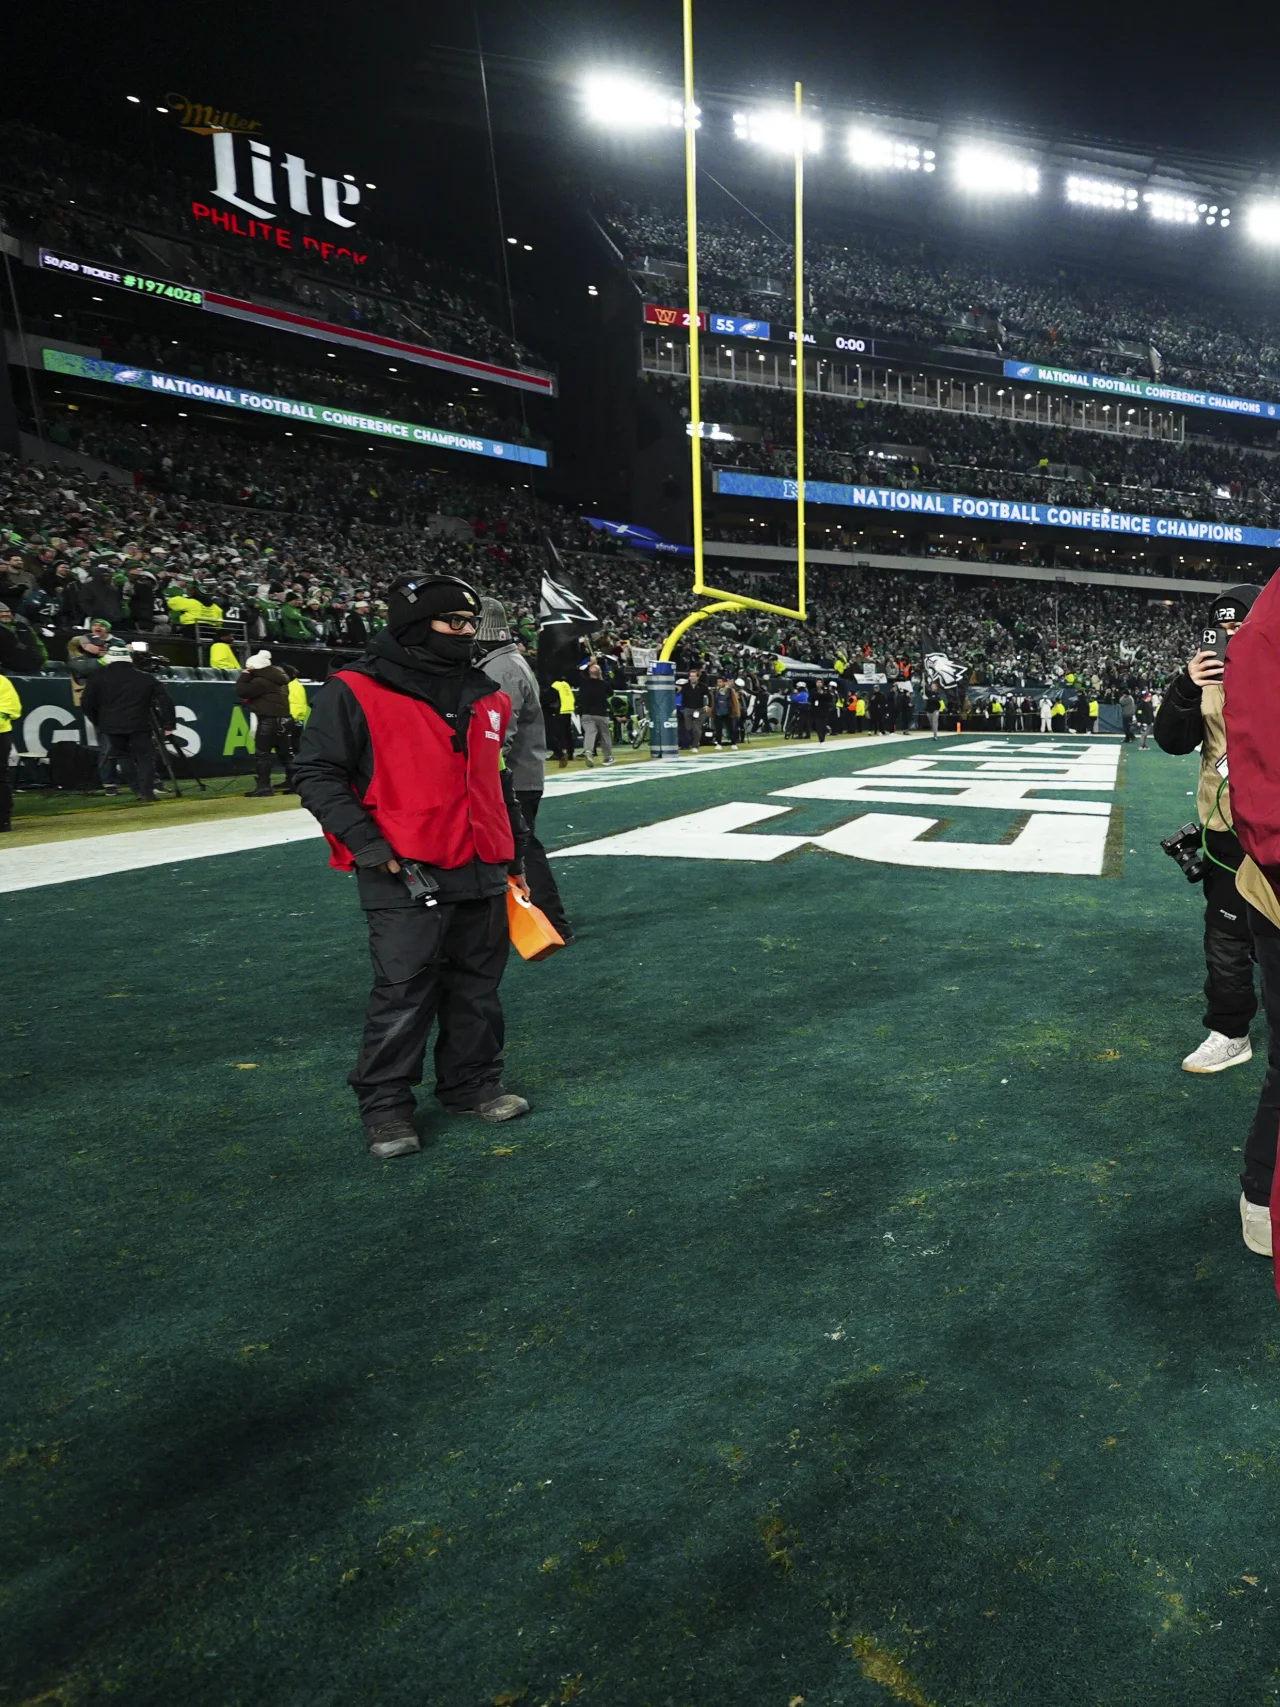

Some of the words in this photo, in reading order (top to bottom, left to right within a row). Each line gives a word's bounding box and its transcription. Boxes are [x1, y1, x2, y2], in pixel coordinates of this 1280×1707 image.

[166, 93, 262, 130] Miller
[209, 125, 360, 228] Lite
[192, 201, 292, 249] PHLITE
[44, 255, 79, 271] 50/50
[80, 264, 122, 283] TICKET:
[123, 274, 202, 304] #1974028
[716, 318, 734, 332] 55
[836, 337, 865, 352] 0:00
[152, 375, 235, 403] NATIONAL
[240, 393, 317, 419] FOOTBALL
[322, 411, 409, 437] CONFERENCE
[413, 428, 483, 452] CHAMPIONS
[1038, 368, 1090, 387] NATIONAL
[1092, 377, 1142, 395] FOOTBALL
[1145, 385, 1206, 404] CONFERENCE
[1208, 396, 1260, 414] CHAMPIONS
[853, 488, 945, 512] NATIONAL
[953, 498, 1040, 522] FOOTBALL
[1047, 508, 1150, 532] CONFERENCE
[1156, 519, 1243, 542] CHAMPIONS
[547, 741, 1121, 875] EAGLES
